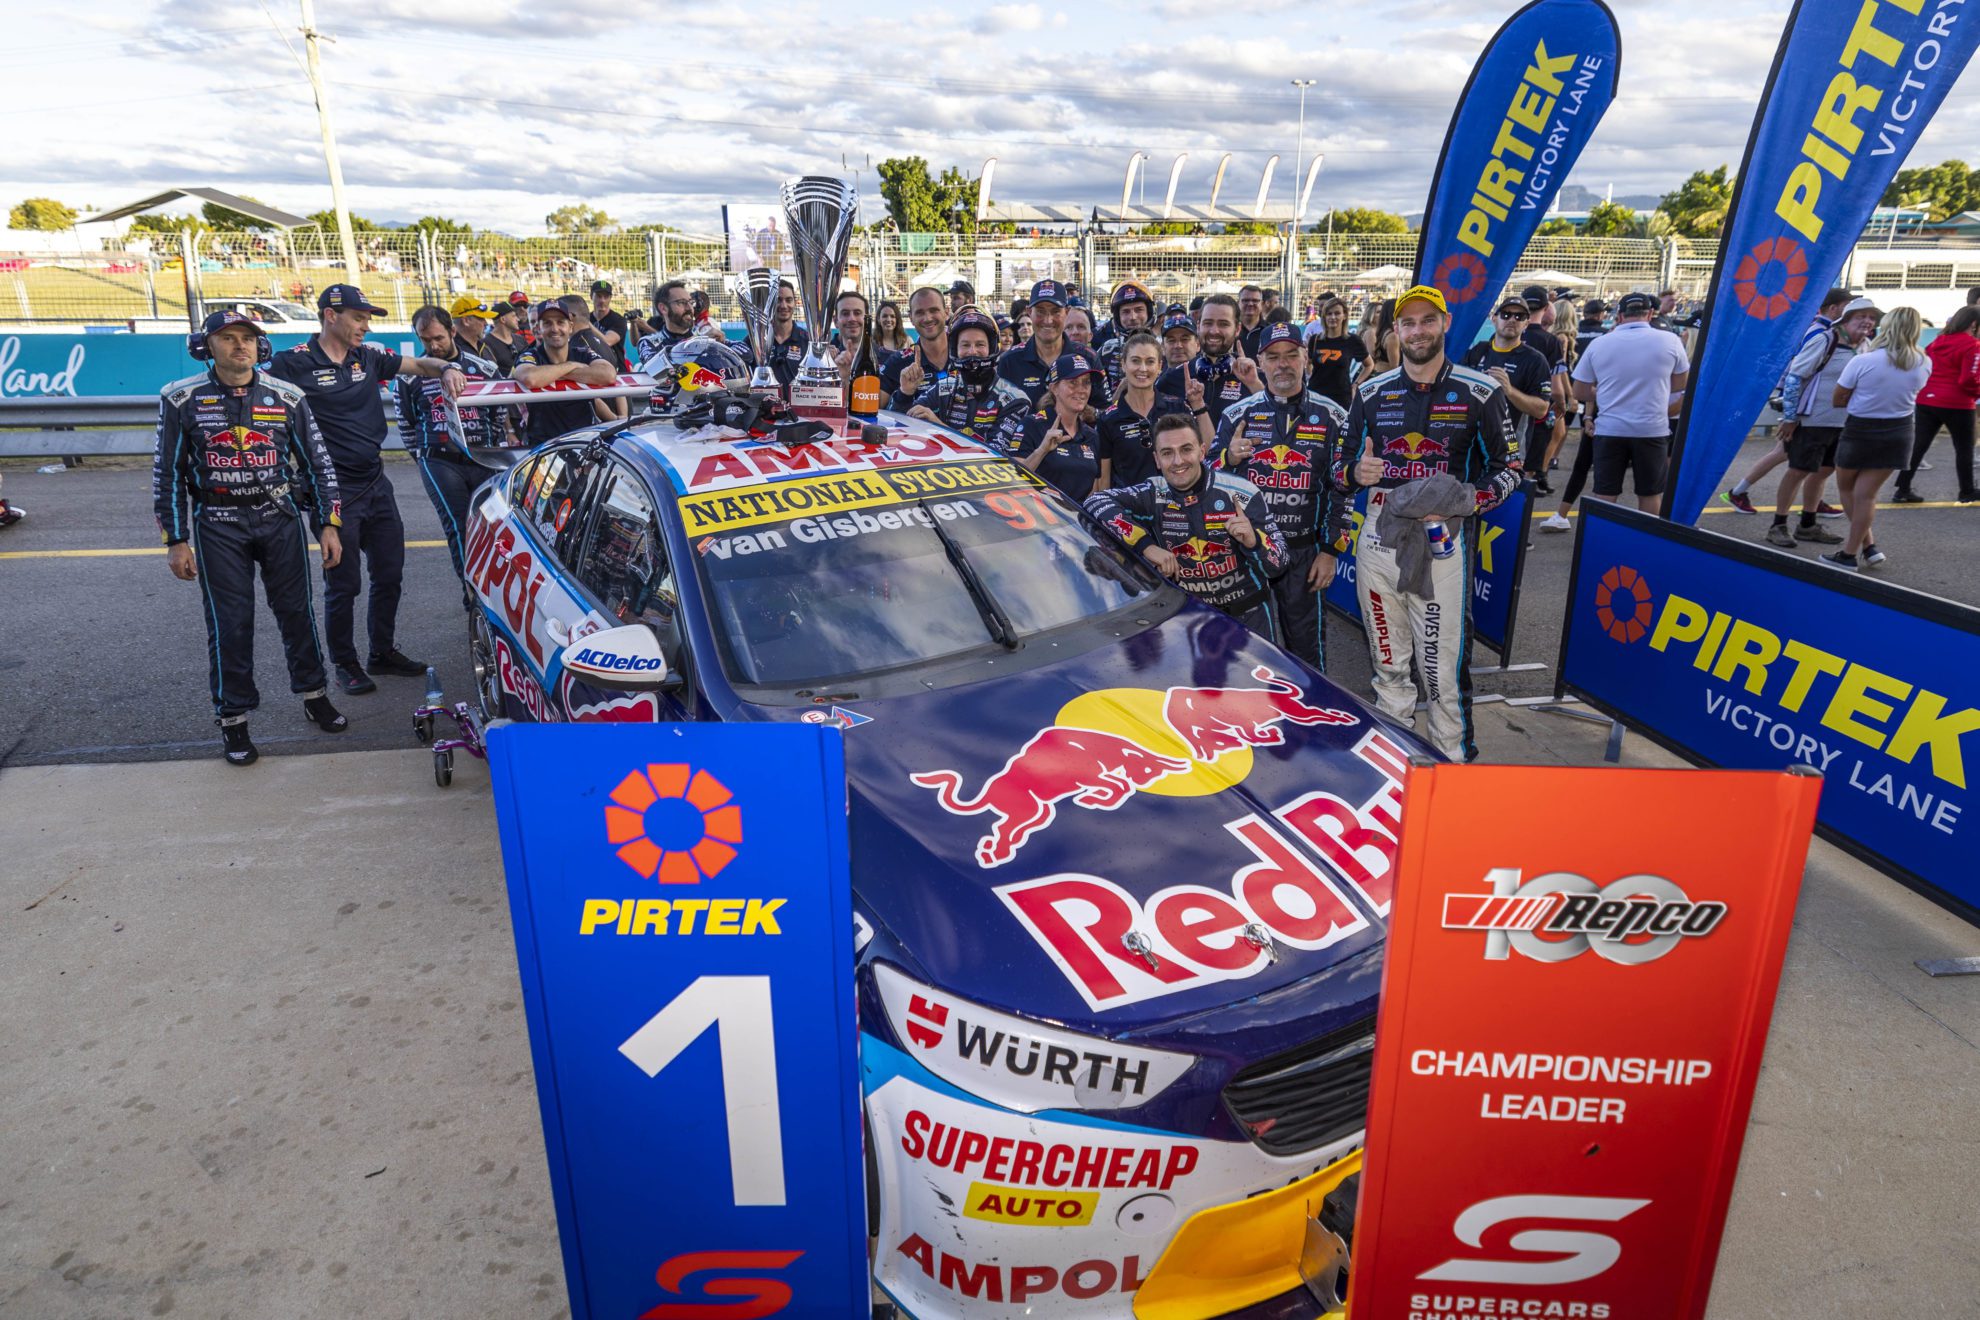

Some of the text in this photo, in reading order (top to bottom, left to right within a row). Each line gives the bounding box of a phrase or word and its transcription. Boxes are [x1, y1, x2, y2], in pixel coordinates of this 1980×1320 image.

[1520, 54, 1602, 211] VICTORY LANE
[1774, 0, 1926, 243] PIRT
[1456, 37, 1578, 258] PIRTEK
[854, 391, 879, 400] FOXTEL
[1362, 386, 1376, 396] OMP
[1472, 384, 1490, 397] OMP
[206, 449, 277, 467] Red Bull
[209, 468, 278, 484] AMPOL
[690, 432, 991, 488] AMPOL
[1384, 460, 1412, 479] Red
[684, 461, 1031, 527] NATIONAL STORAGE
[1247, 469, 1311, 490] Red Bull
[1263, 491, 1309, 506] MPOL
[709, 527, 786, 560] van
[789, 499, 980, 543] Gisbergen
[983, 489, 1058, 530] 97
[1205, 555, 1238, 580] Bull
[1371, 601, 1393, 667] AMPLIFY
[1425, 602, 1441, 639] GIVES
[573, 647, 661, 671] ACDelco
[1424, 640, 1439, 664] YOU
[1649, 593, 1980, 790] PIRTEK
[1706, 688, 1962, 835] VICTORY LANE
[579, 898, 788, 936] PIRTEK
[992, 812, 1369, 1012] Red
[1546, 893, 1728, 942] Repco
[957, 1019, 1150, 1095] WÜRTH
[1411, 1049, 1712, 1087] CHAMPIONSHIP
[617, 975, 787, 1206] 1
[1480, 1093, 1627, 1125] LEADER
[902, 1109, 1200, 1190] SUPERCHEAP
[977, 1193, 1083, 1219] AUTO
[896, 1232, 1148, 1304] AMPOL
[1410, 1294, 1610, 1319] SUPERCARS
